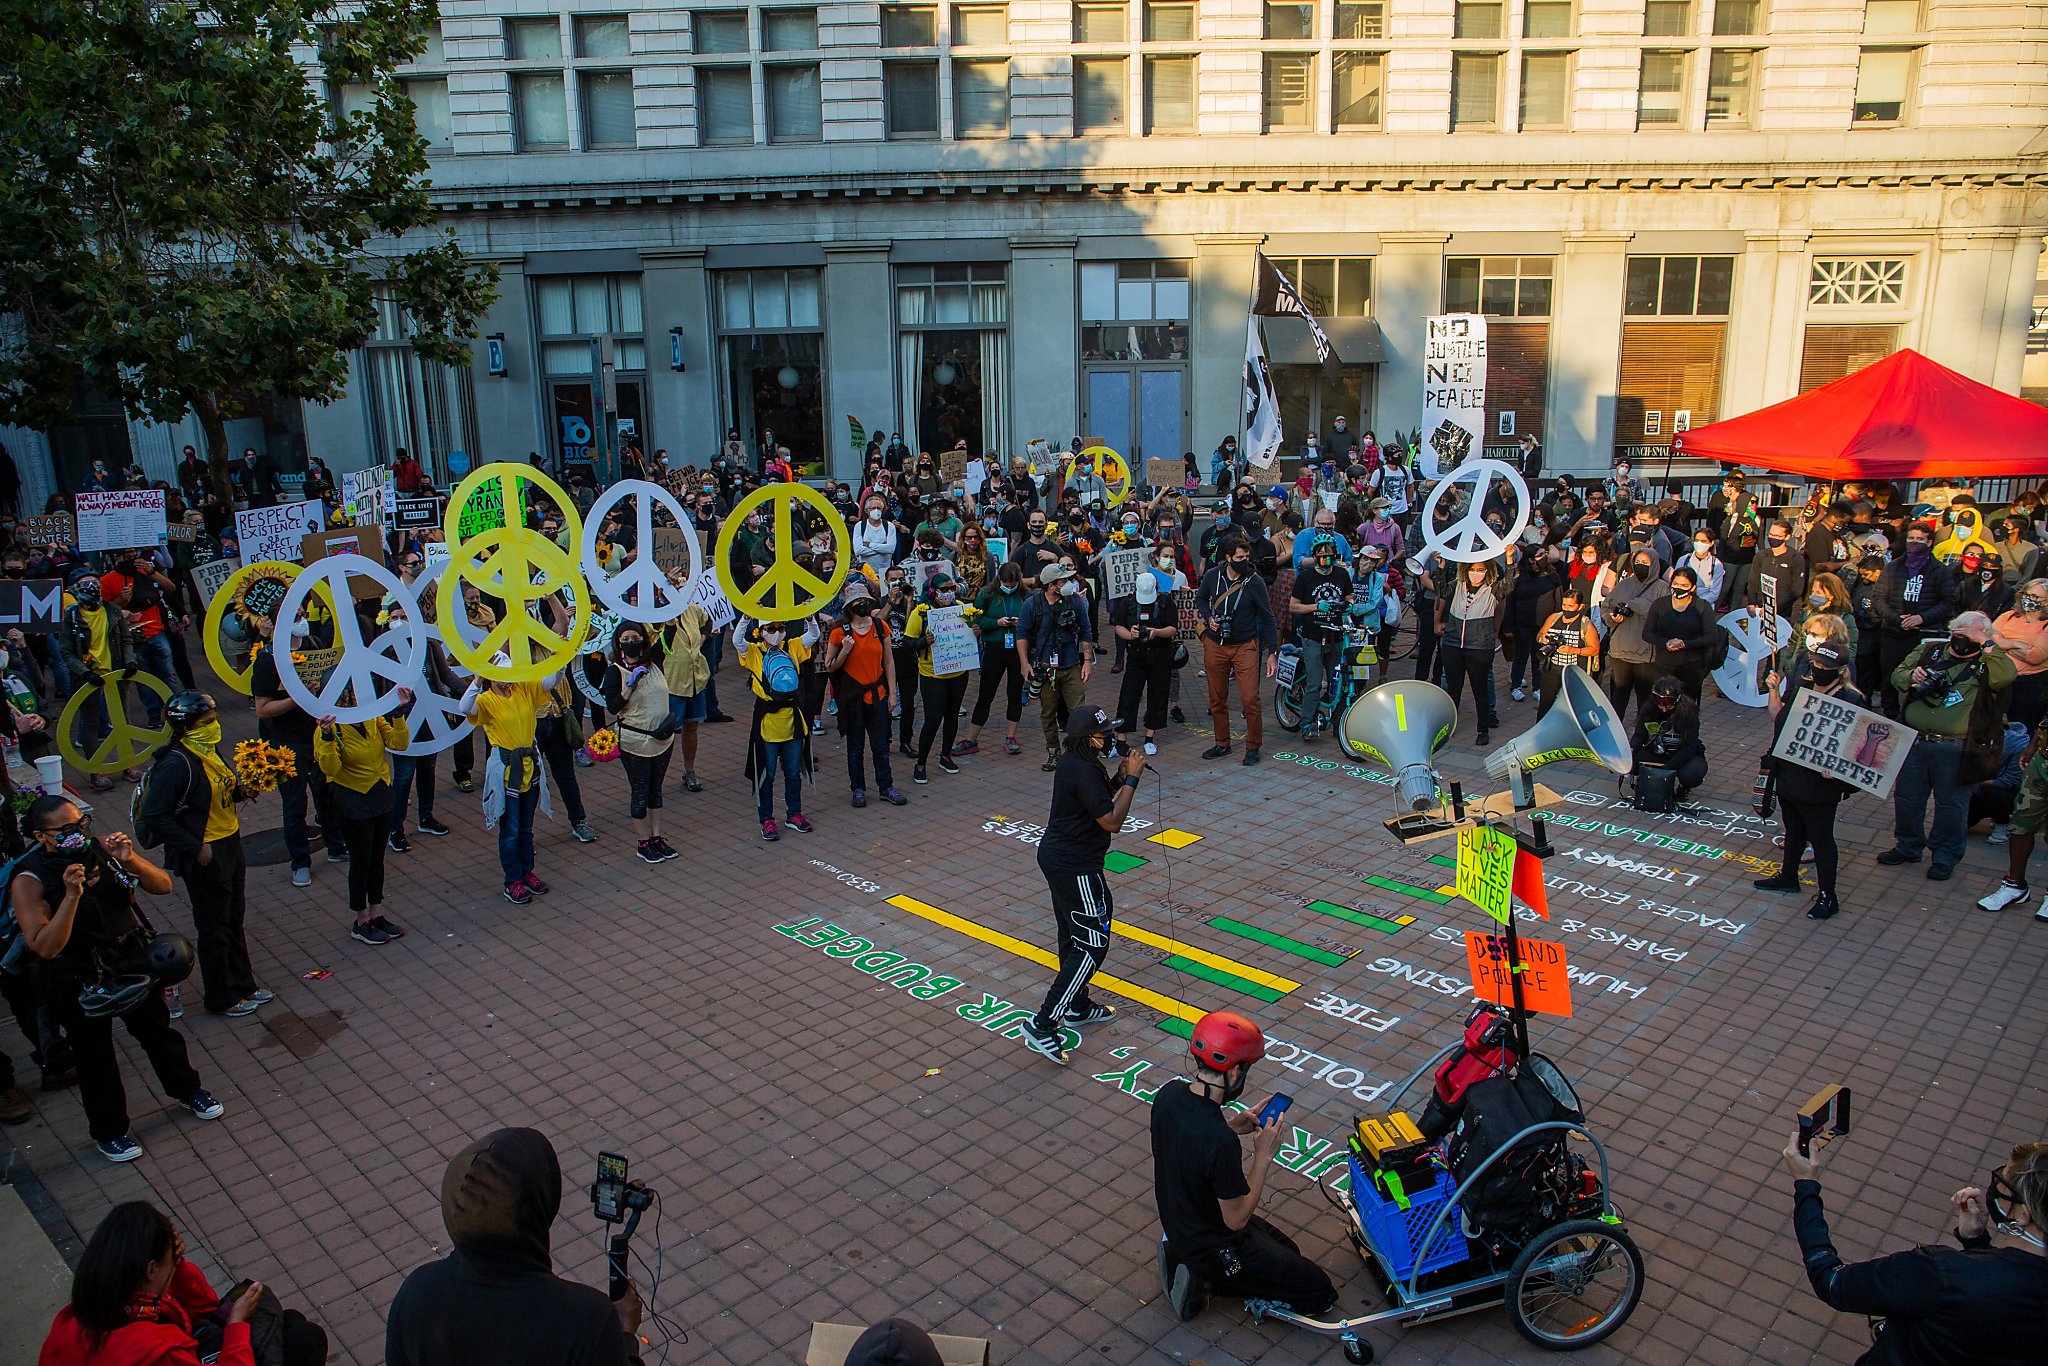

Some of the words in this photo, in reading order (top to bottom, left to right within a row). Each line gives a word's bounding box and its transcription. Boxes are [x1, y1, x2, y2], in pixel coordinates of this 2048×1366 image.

[1430, 319, 1469, 339] NO
[1427, 340, 1486, 359] JUSTICE
[1427, 363, 1472, 383] NO
[1426, 388, 1485, 409] PEACE
[1651, 446, 1670, 457] SMAL
[668, 465, 696, 483] DEFUND
[1151, 464, 1168, 472] WALL
[1172, 464, 1181, 472] OF
[1150, 474, 1181, 483] VETERANS
[77, 493, 99, 503] WAIT
[103, 493, 120, 502] HAS
[123, 491, 161, 500] ALMOST
[78, 501, 110, 516] ALWAYS
[112, 500, 138, 509] MEANT
[139, 498, 166, 510] NEVER
[239, 504, 307, 529] RESPECT
[398, 503, 417, 511] BLACK
[29, 516, 72, 527] BLACK
[29, 525, 72, 535] LIVES
[241, 518, 302, 541] EXISTENCE
[459, 515, 477, 528] EEP
[30, 533, 74, 546] MATTER
[168, 524, 193, 541] AYLOR
[268, 535, 281, 543] OR
[652, 532, 690, 552] Libera
[259, 537, 292, 552] EXPECT
[428, 546, 450, 556] Blac
[652, 550, 691, 572] Portla
[1111, 552, 1141, 566] FEDS
[1114, 562, 1140, 574] OFF
[199, 563, 230, 580] FEDS
[246, 579, 269, 605] BLACK
[253, 584, 277, 612] LIVES
[259, 586, 287, 617] MATTER
[303, 650, 338, 662] EFUND
[307, 659, 334, 670] POLICE
[942, 661, 963, 672] REPEAT
[1803, 694, 1857, 725] FEDS
[1801, 711, 1849, 737] OFF
[1794, 728, 1841, 754] OUR
[1528, 751, 1561, 768] BLACK
[1785, 740, 1884, 789] STREETS!
[1462, 829, 1513, 871] BLACK
[1461, 847, 1508, 888] LIVES
[1560, 847, 1701, 888] LIBRARY
[836, 873, 882, 894] $330
[1459, 868, 1505, 918] MATTER
[1661, 905, 1749, 937] RACE
[1586, 925, 1690, 963] PARKS
[772, 916, 964, 1001] BUDGET
[1304, 991, 1402, 1034] FIRE
